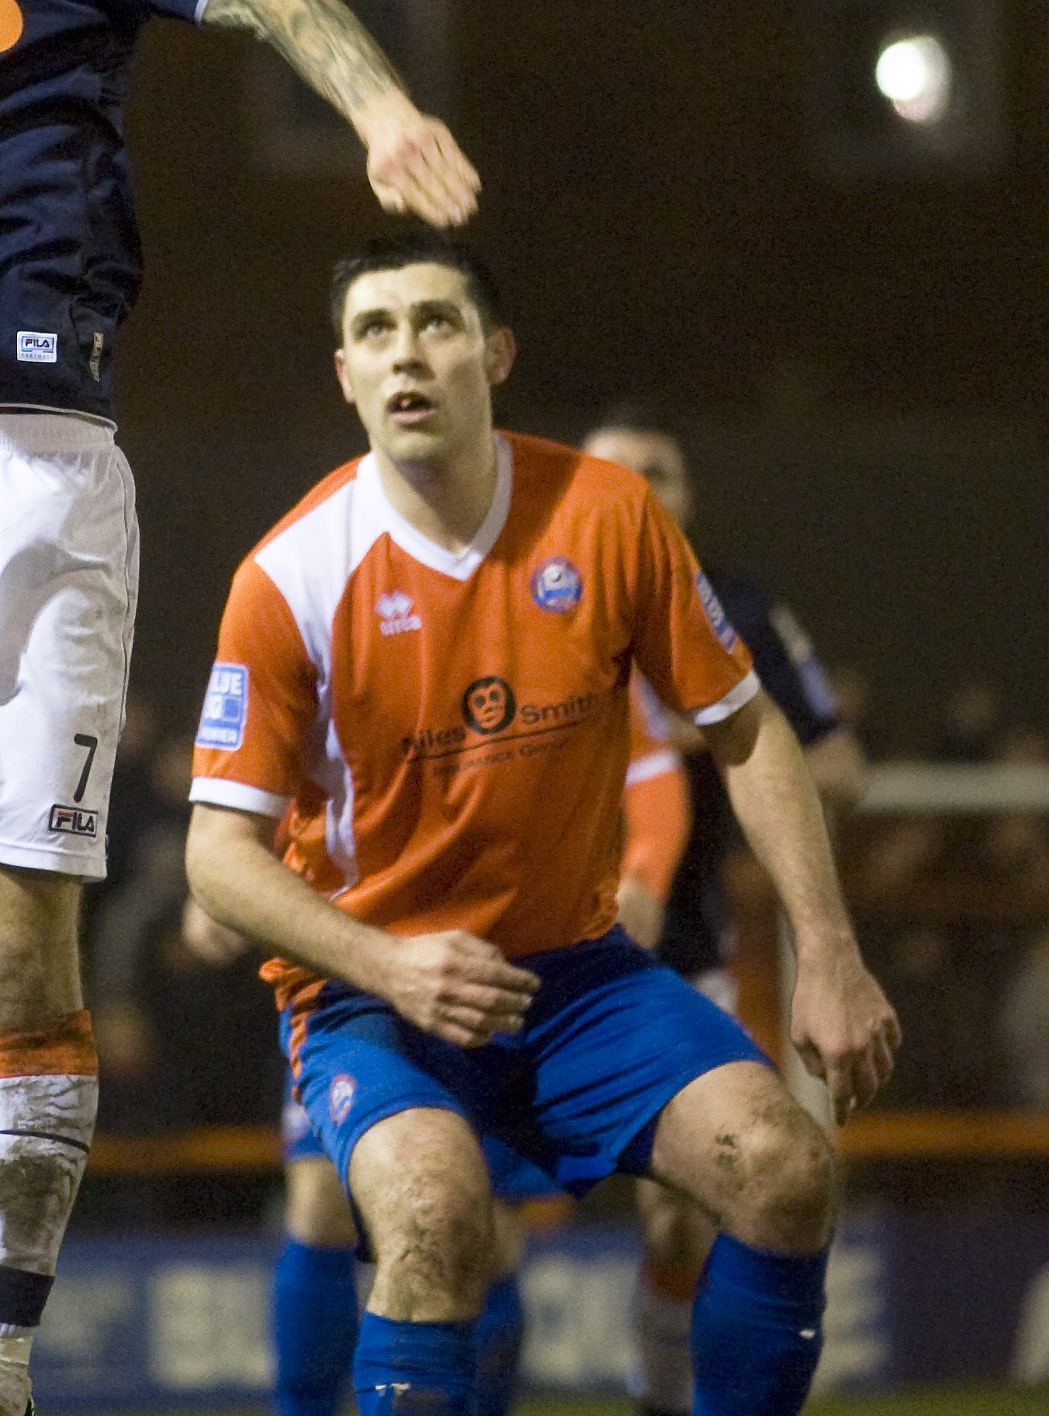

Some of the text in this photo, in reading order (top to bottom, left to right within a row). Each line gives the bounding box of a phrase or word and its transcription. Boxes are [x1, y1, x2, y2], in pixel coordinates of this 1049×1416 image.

[25, 339, 50, 348] FILA
[211, 671, 243, 695] LUE
[74, 733, 98, 803] 7
[56, 810, 95, 832] FILA
